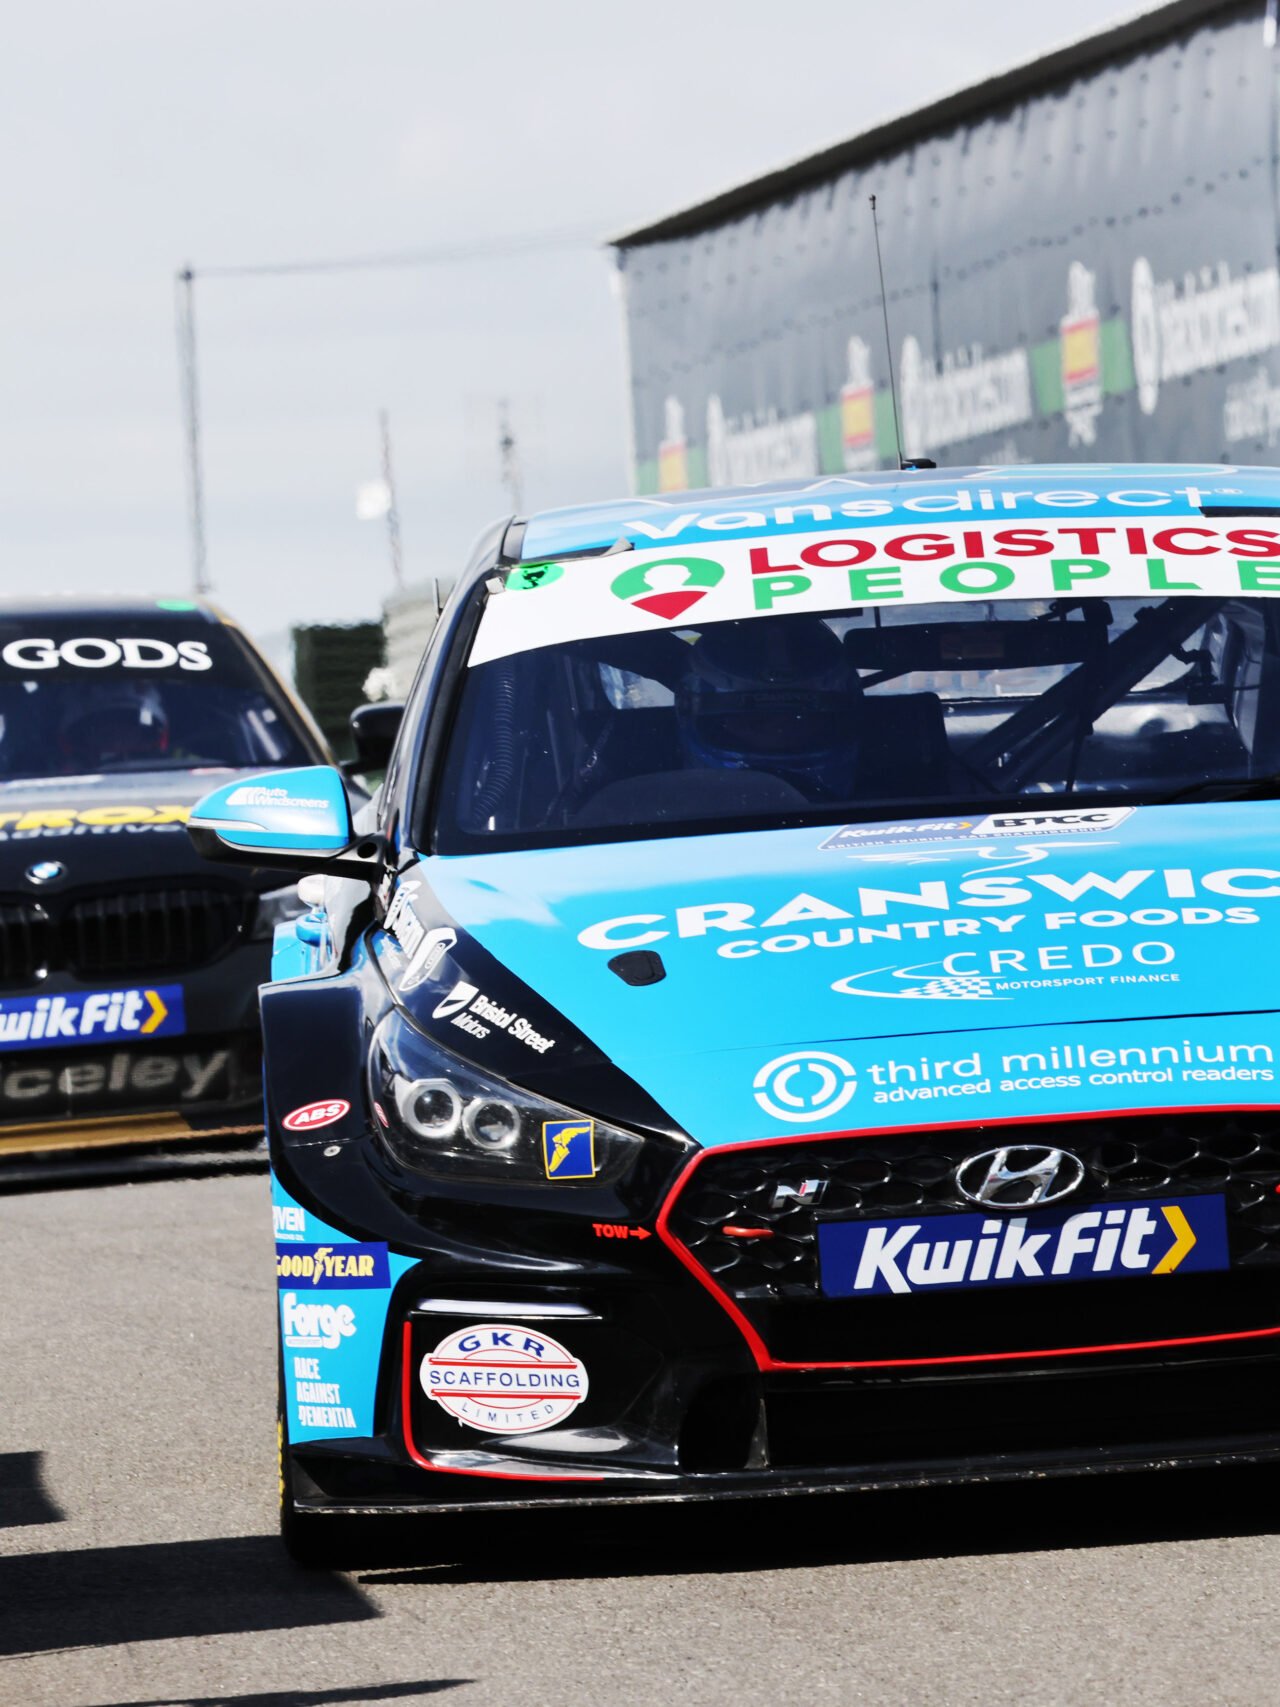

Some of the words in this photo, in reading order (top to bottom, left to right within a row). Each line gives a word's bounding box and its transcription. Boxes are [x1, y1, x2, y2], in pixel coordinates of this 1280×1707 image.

[2, 638, 213, 671] GODS
[993, 813, 1110, 829] BTCC
[717, 914, 1025, 959] COUNTRY
[1045, 907, 1260, 930] FOODS
[942, 941, 1175, 977] CREDO
[996, 976, 1104, 991] MOTORSPORT
[1110, 973, 1180, 984] FINANCE
[450, 1012, 492, 1039] Motors
[469, 994, 517, 1029] Bristol
[508, 1018, 556, 1054] Street
[867, 1052, 981, 1085] third
[1002, 1040, 1273, 1073] millennium
[873, 1077, 991, 1104] advanced
[1000, 1073, 1081, 1092] access
[1089, 1066, 1174, 1086] control
[1182, 1064, 1274, 1082] readers
[293, 1104, 341, 1125] ABS
[592, 1223, 628, 1240] TOW
[458, 1332, 545, 1358] GKR
[294, 1357, 321, 1380] RACE
[430, 1369, 580, 1388] SCAFFOLDING
[296, 1381, 341, 1405] AGAINST
[461, 1402, 554, 1423] LIMITED
